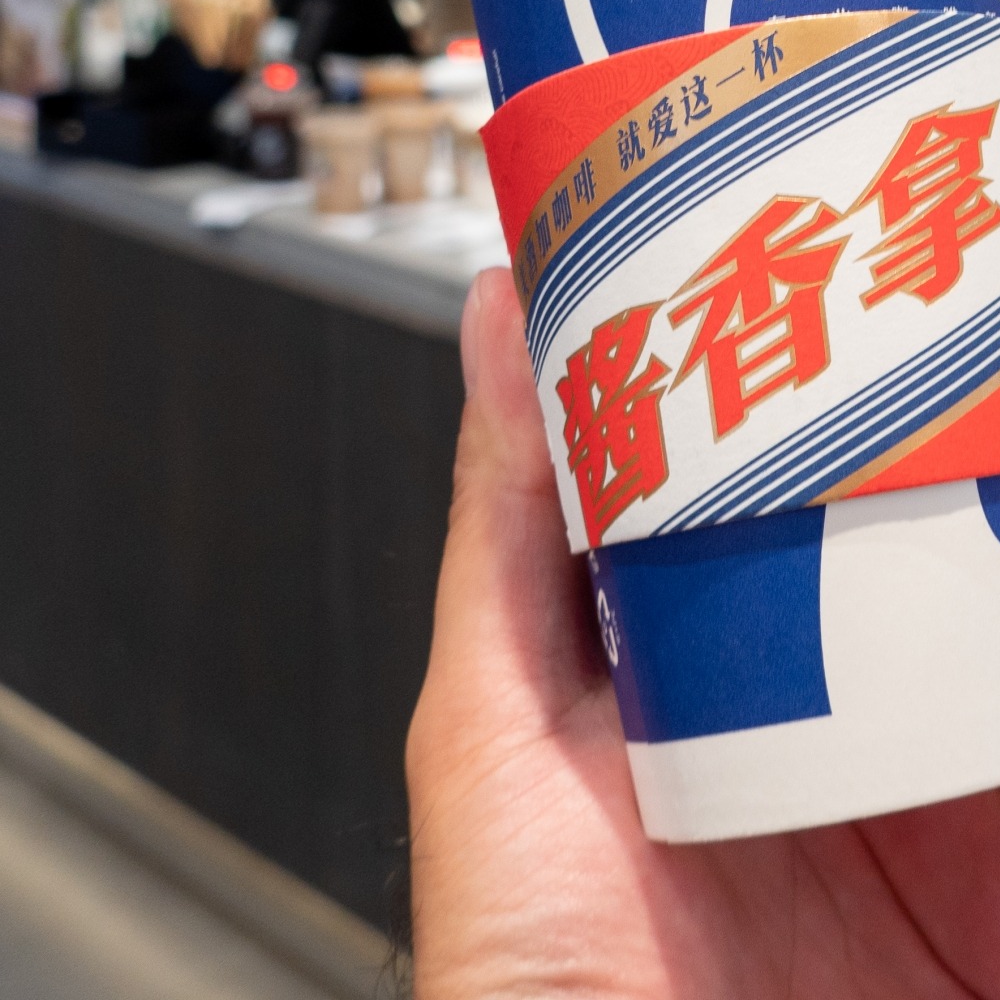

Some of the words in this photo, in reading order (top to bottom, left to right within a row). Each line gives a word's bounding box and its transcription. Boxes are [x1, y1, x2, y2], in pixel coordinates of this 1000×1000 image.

[616, 30, 784, 172] 就爱这一杯
